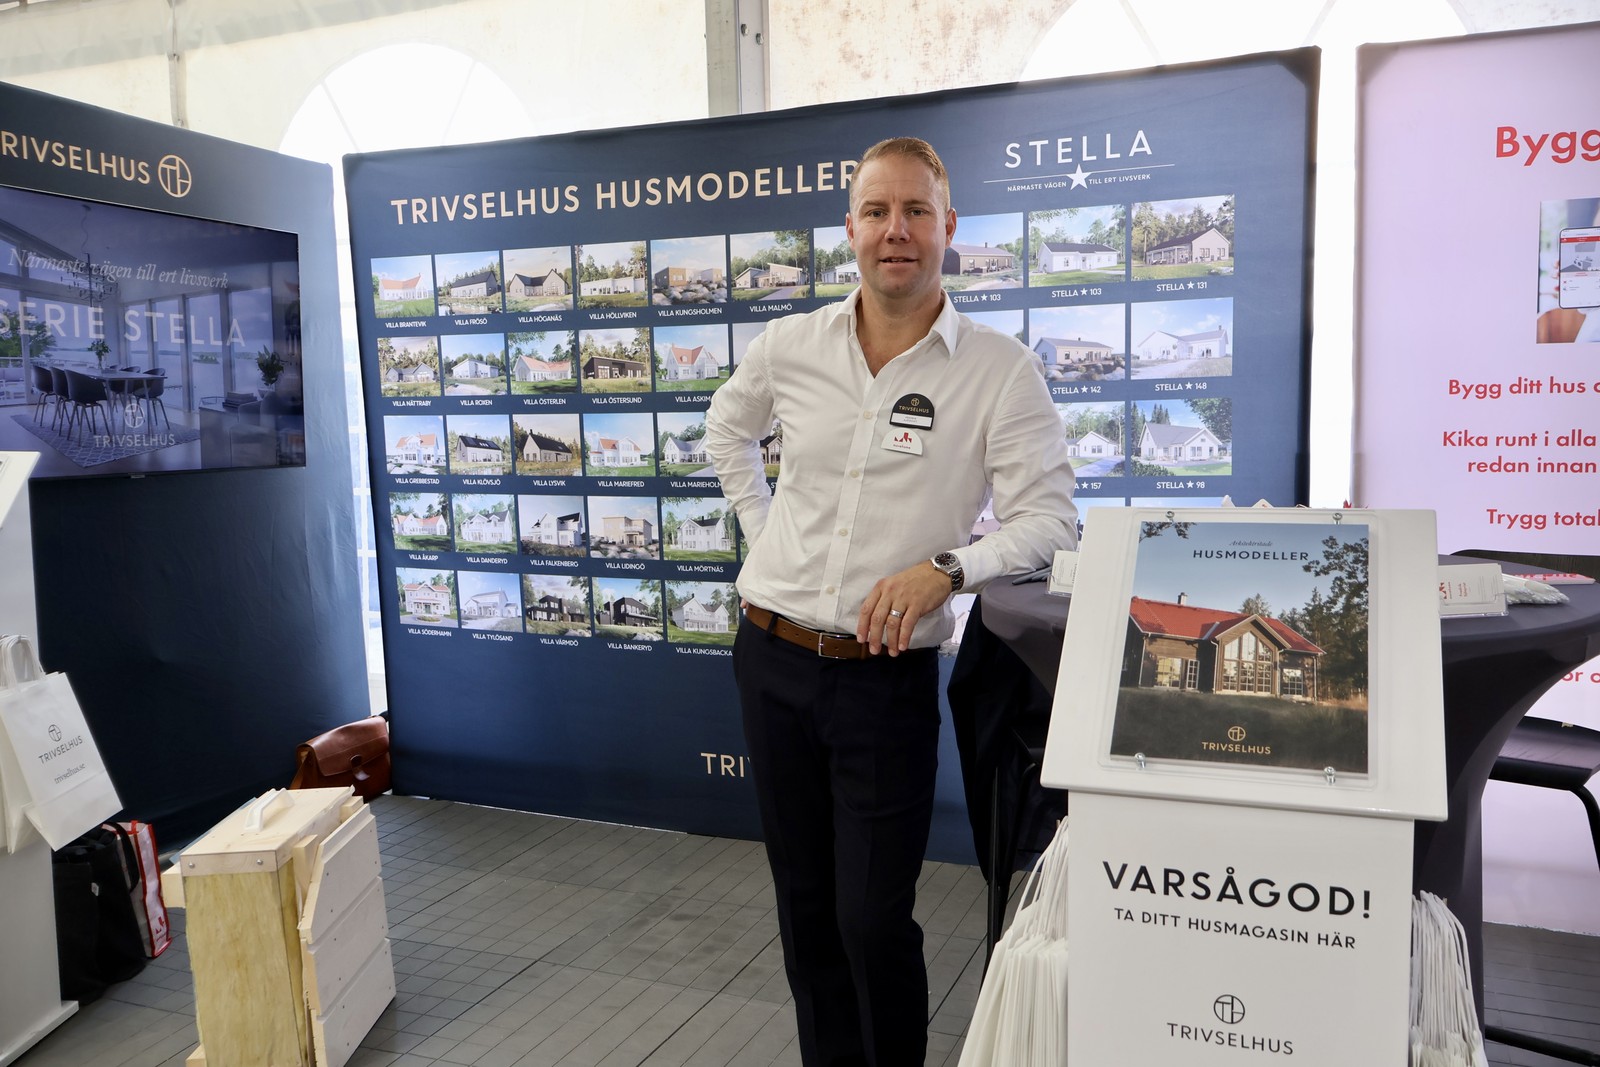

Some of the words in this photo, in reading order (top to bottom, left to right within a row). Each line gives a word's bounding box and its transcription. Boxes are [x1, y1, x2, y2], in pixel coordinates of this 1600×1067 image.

[1004, 130, 1152, 169] STELLA
[1496, 126, 1600, 167] Bygg
[1007, 183, 1042, 192] NÄRMASTE
[1044, 181, 1067, 189] VÄGEN
[1104, 176, 1117, 184] ERT
[1119, 173, 1151, 183] LIVSVERK
[390, 185, 580, 225] TRIVSELHUS
[596, 160, 858, 210] HUSMODELLER
[8, 248, 87, 274] Närmaste
[90, 260, 133, 283] vägen
[136, 263, 157, 281] till
[158, 268, 178, 284] ert
[180, 267, 230, 289] livsverk
[1156, 282, 1185, 292] STELLA
[1196, 281, 1208, 289] 131
[953, 294, 979, 303] STELLA
[989, 293, 1001, 302] 103
[1051, 288, 1079, 298] STELLA
[1089, 287, 1102, 296] 103
[675, 307, 723, 316] KUNGSHOLMEN
[749, 305, 767, 313] VILLA
[767, 302, 792, 312] MALMÖ
[469, 317, 488, 325] FRÖSÖ
[533, 314, 563, 323] HÖGANÄS
[605, 311, 637, 320] HÖLLVIKEN
[124, 309, 246, 348] STELLA
[1052, 386, 1079, 395] STELLA
[1090, 385, 1102, 394] 142
[1155, 383, 1183, 392] STELLA
[1194, 382, 1207, 390] 148
[1449, 379, 1501, 399] Bygg
[1509, 376, 1542, 394] ditt
[1549, 376, 1586, 394] hus
[539, 397, 566, 405] ÖSTERLEN
[608, 396, 642, 404] ÖSTERSUND
[94, 433, 176, 448] TRIVSELHUS
[1443, 429, 1488, 447] Kika
[1496, 433, 1537, 447] runt
[1544, 430, 1549, 447] i
[1556, 429, 1596, 447] alla
[1468, 455, 1529, 473] redan
[1537, 457, 1597, 473] innan
[614, 480, 645, 488] MARIEFRED
[1091, 482, 1102, 490] 157
[1156, 481, 1184, 489] STELLA
[1196, 481, 1205, 489] 98
[1486, 508, 1547, 530] Trygg
[1193, 550, 1309, 561] HUSMODELLER
[694, 565, 724, 573] MÖRTNÄS
[486, 633, 514, 642] TYLÖSAND
[540, 637, 555, 645] VILLA
[555, 638, 579, 647] VÄRMDÖ
[623, 643, 653, 651] BANKERYD
[676, 646, 693, 654] VILLA
[693, 647, 733, 657] KUNGSBACKA
[38, 735, 83, 764] TRIVSELHUS
[1201, 741, 1271, 755] TRIVSELHUS
[701, 752, 750, 778] TRI
[1102, 860, 1371, 919] VARSÅGOD!
[1114, 907, 1134, 922] TA
[1141, 911, 1181, 928] DITT
[1188, 917, 1309, 944] HUSMAGASIN
[1317, 931, 1356, 949] HÄR
[1167, 1022, 1293, 1055] TRIVSELHUS
